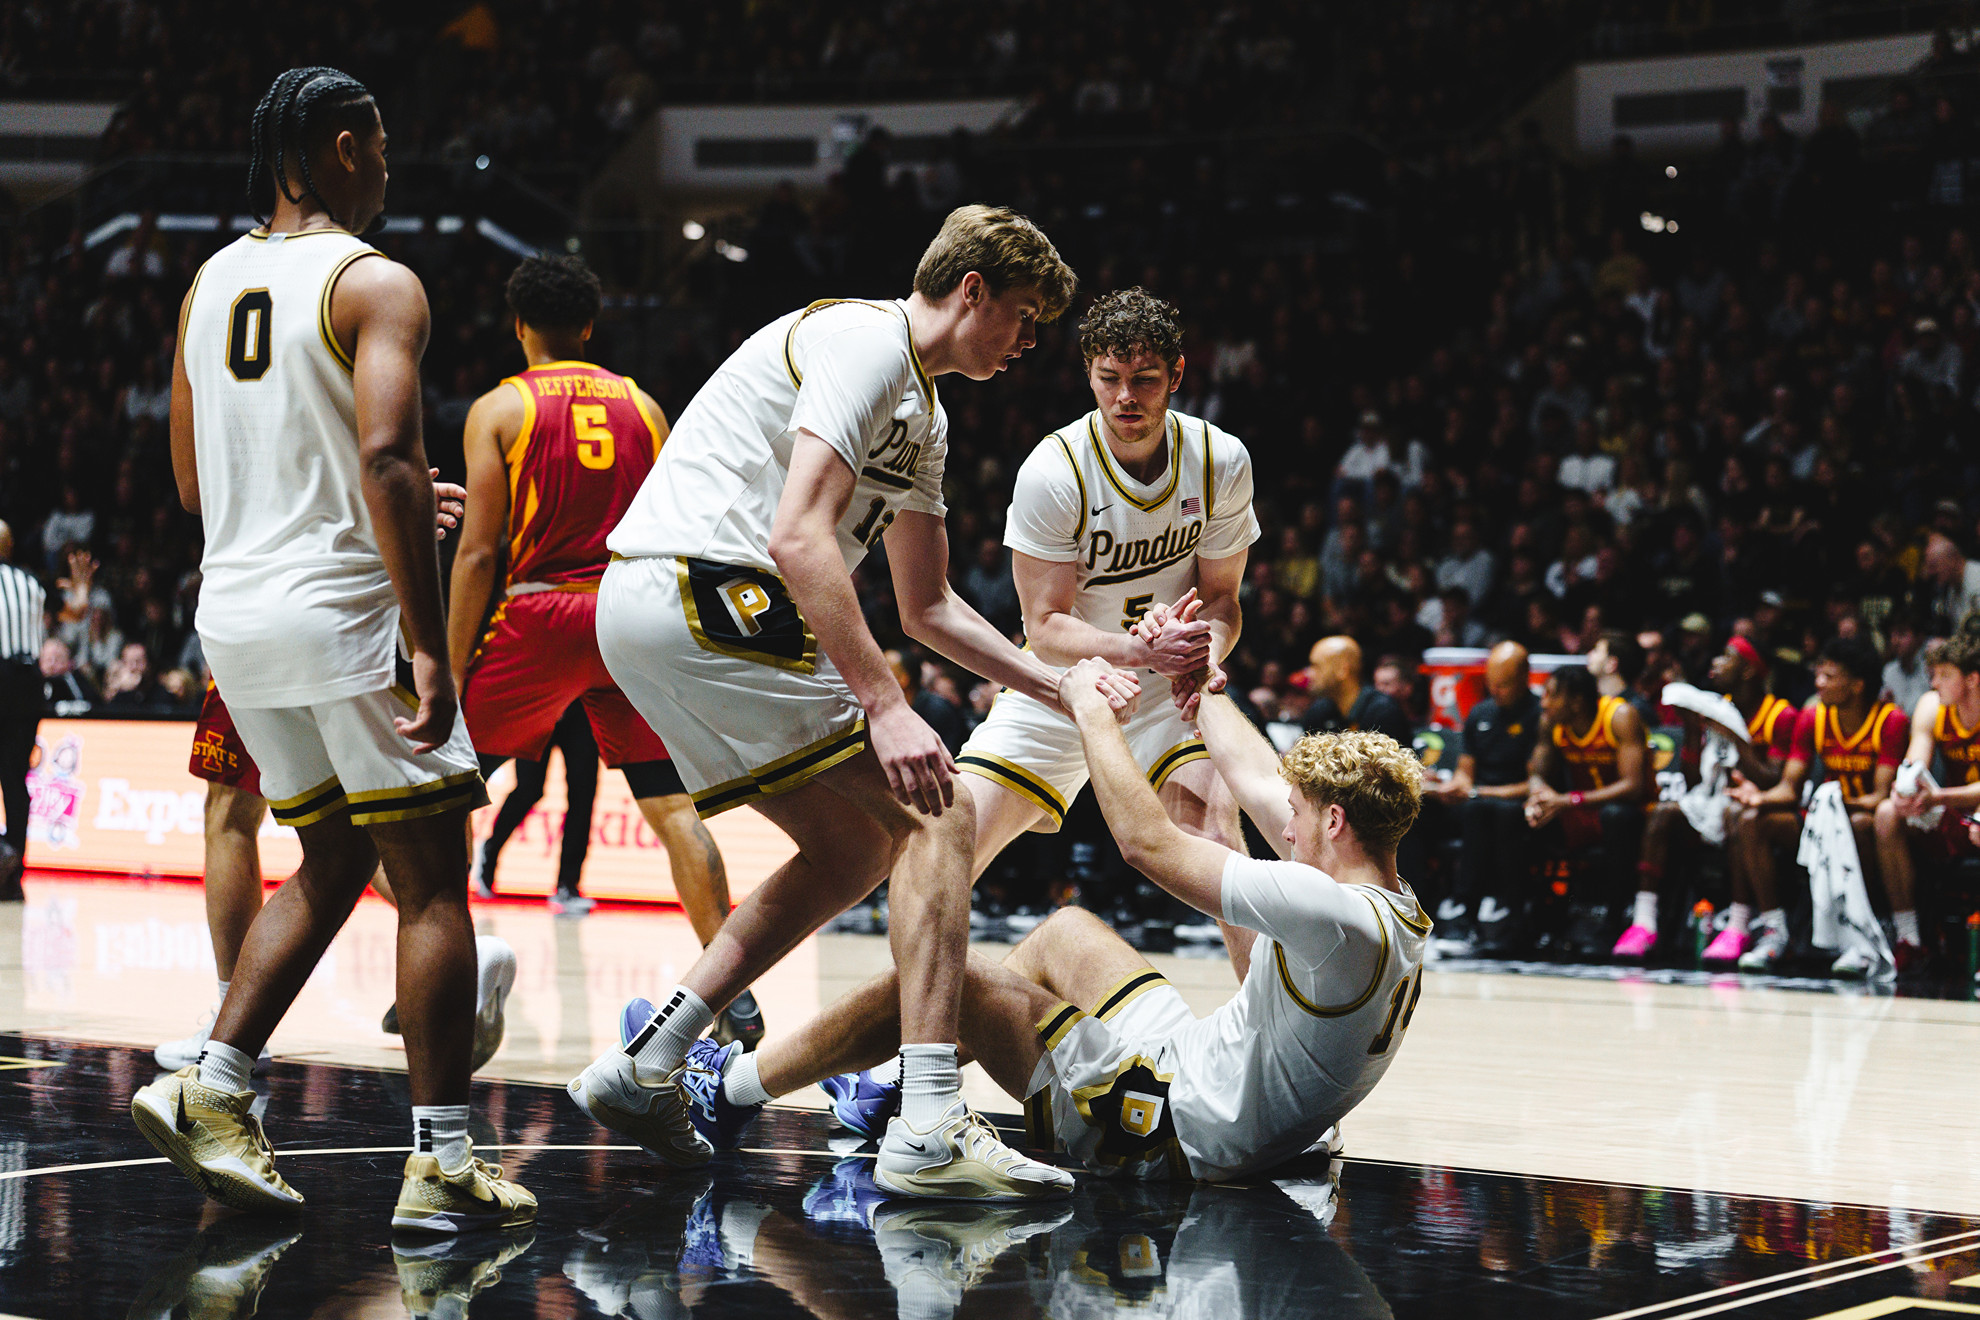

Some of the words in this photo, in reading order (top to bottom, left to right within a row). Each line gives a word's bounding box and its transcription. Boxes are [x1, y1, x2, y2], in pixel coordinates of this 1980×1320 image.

[225, 287, 273, 382] 0
[536, 374, 629, 400] JEFFERSON
[571, 403, 616, 470] 5
[1084, 520, 1203, 574] Purdue
[192, 740, 238, 769] STATE
